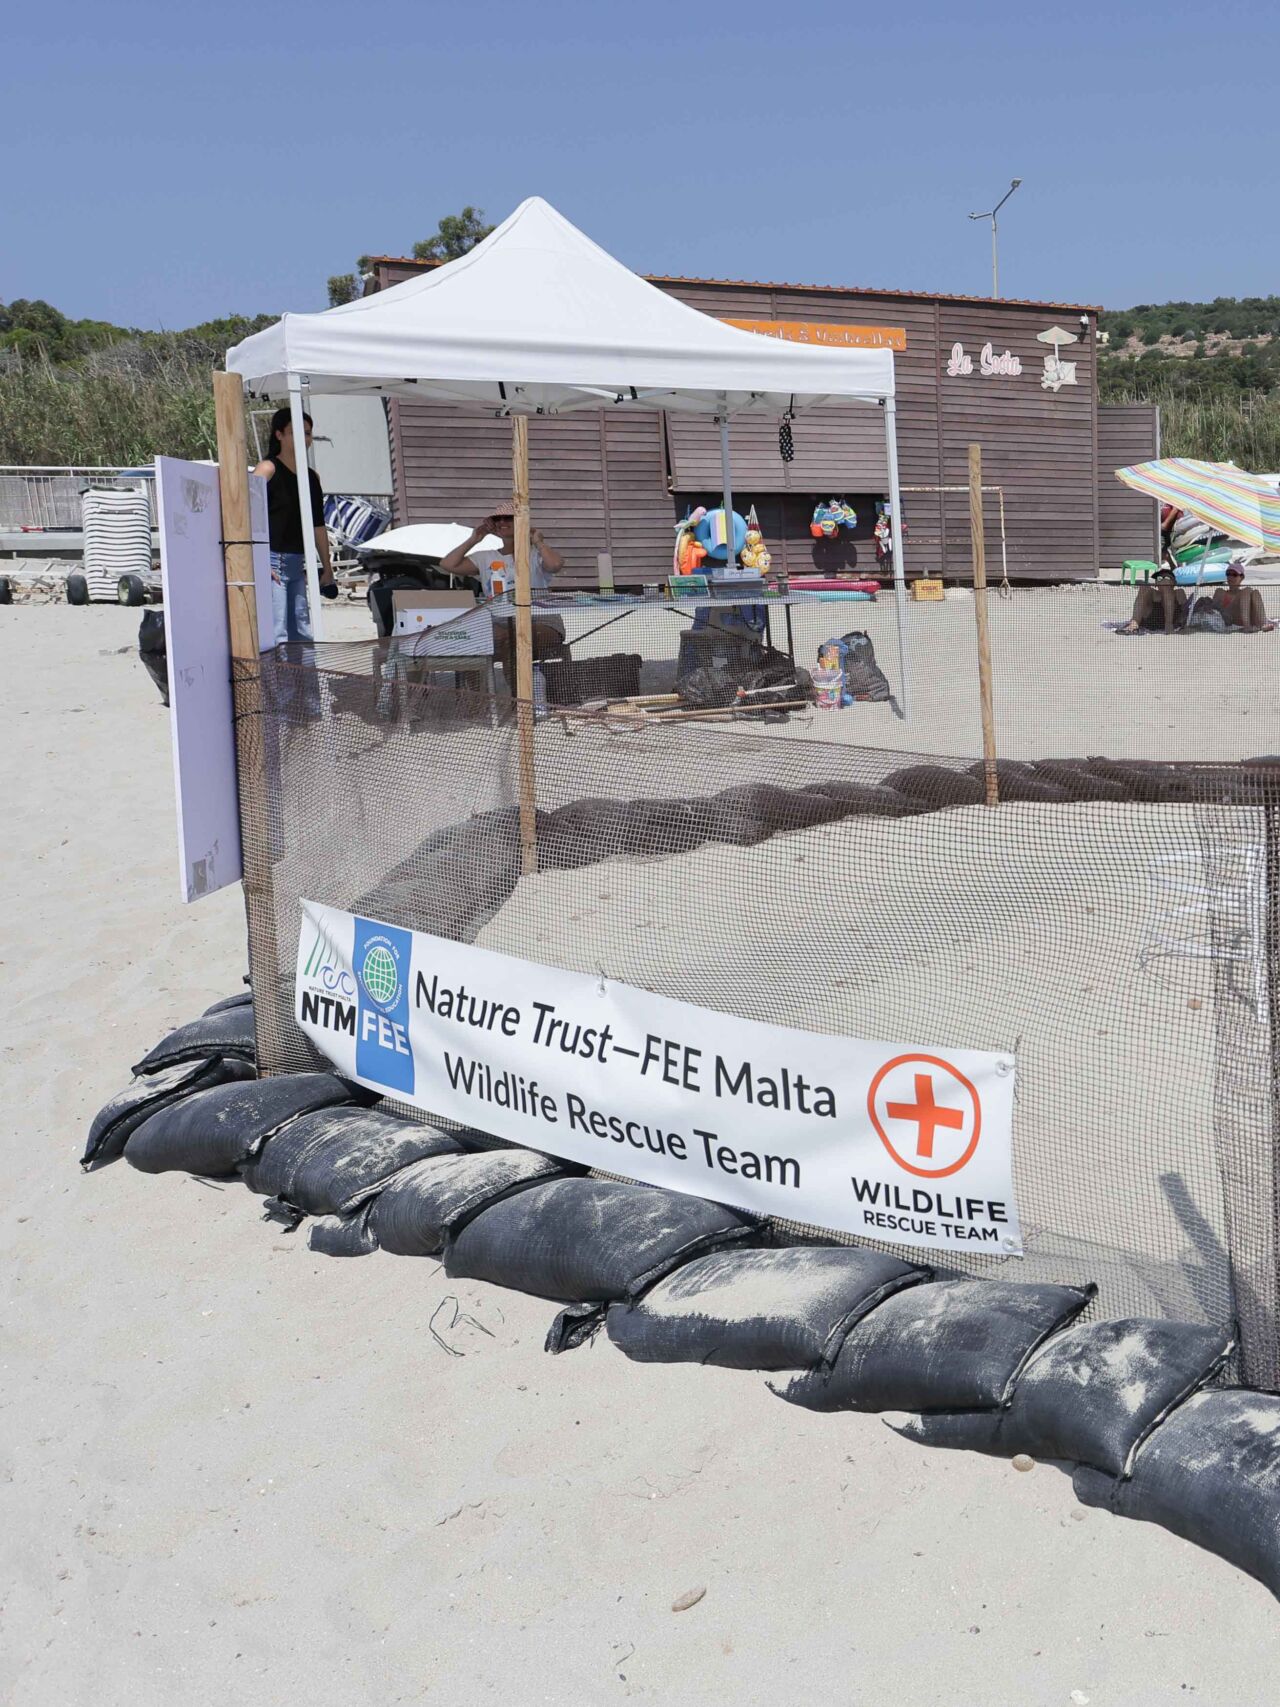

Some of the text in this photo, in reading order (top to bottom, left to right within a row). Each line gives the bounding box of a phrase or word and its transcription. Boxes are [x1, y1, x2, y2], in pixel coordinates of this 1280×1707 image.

[947, 342, 1023, 376] La Sosta
[363, 935, 392, 950] FOUNDATION
[391, 944, 401, 960] FOR
[302, 991, 357, 1037] NTM
[309, 986, 351, 1002] NATURE TRUST MALTA
[362, 1009, 410, 1056] FEE
[415, 970, 521, 1037] Nature
[715, 1055, 837, 1118] Malta
[444, 1051, 801, 1189] Wildlife Rescue Team
[851, 1176, 1009, 1223] WILDLIFE
[863, 1210, 999, 1241] RESCUE TEAM
